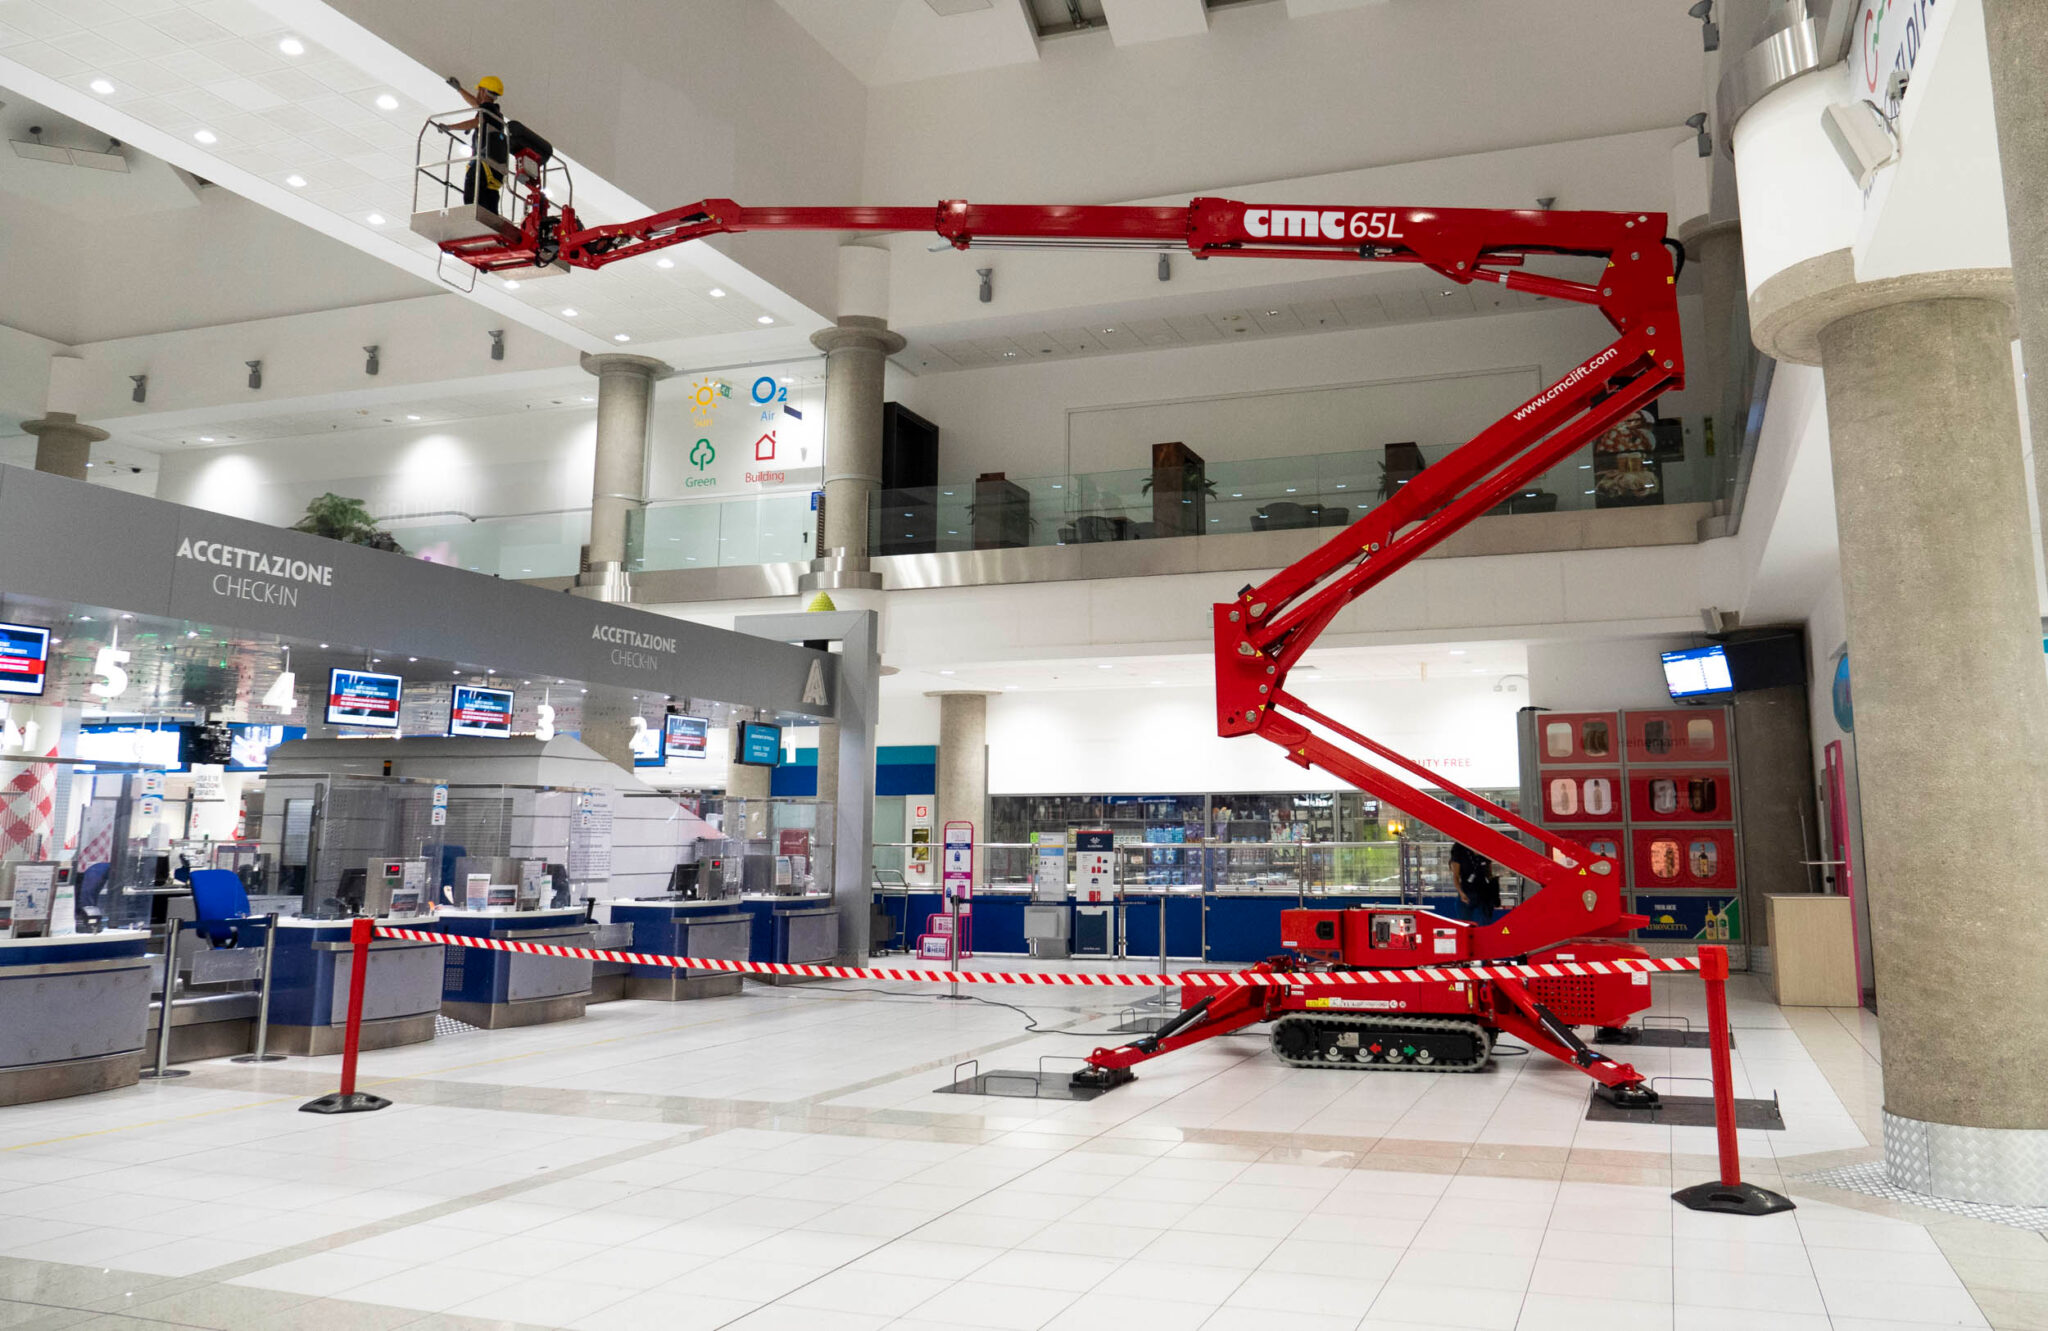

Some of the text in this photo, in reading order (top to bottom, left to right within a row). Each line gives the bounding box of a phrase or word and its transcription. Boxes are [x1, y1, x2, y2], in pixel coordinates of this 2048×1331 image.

[1350, 212, 1403, 239] 65L
[1513, 347, 1618, 421] www.cmclift.com
[760, 411, 775, 421] Air
[685, 477, 716, 488] Green
[745, 471, 785, 484] Building
[176, 537, 333, 586] ACCETTAZIONE
[213, 574, 299, 608] CHECK-IN
[591, 624, 677, 654] ACCETTAZIONE
[90, 647, 131, 699] 5
[610, 648, 658, 671] CHECK-IN
[261, 672, 298, 715] 4
[802, 658, 829, 706] A
[535, 704, 555, 741] 3
[628, 716, 649, 749] 2
[1443, 758, 1472, 768] FREE
